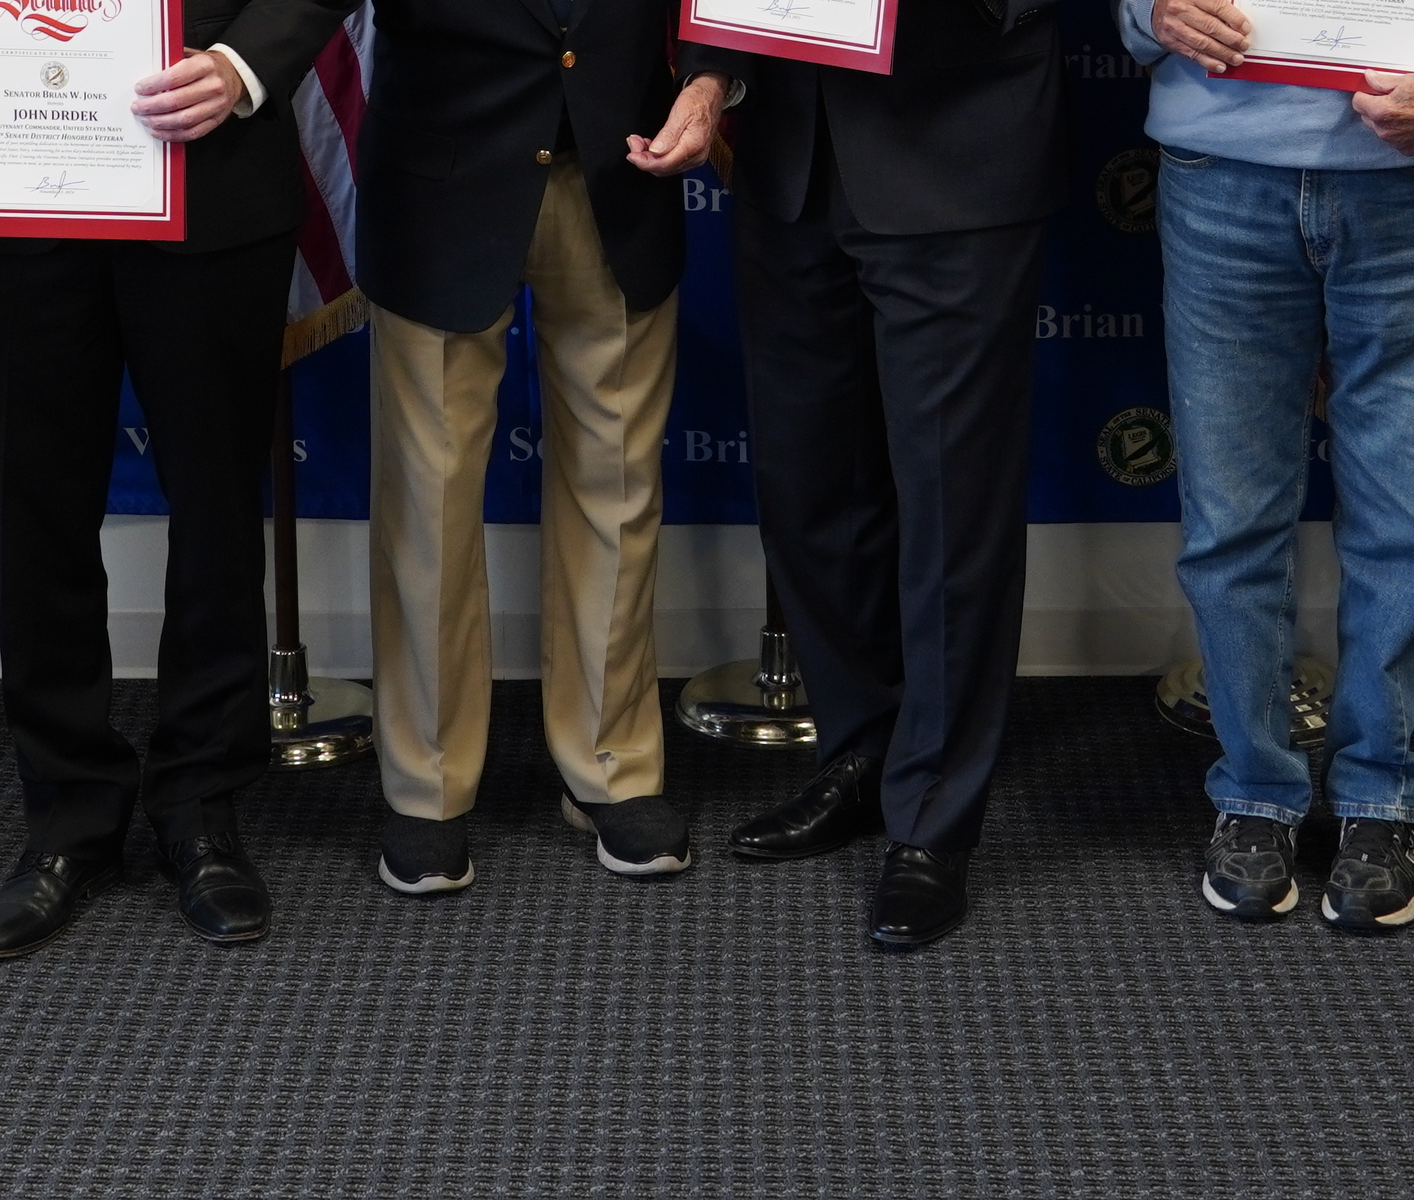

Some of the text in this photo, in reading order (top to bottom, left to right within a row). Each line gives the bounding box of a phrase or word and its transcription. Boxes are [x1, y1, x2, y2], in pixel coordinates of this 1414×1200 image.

[3, 89, 108, 101] SENATOR BRIAN W. JONES
[13, 108, 98, 122] JOHN DRDEK
